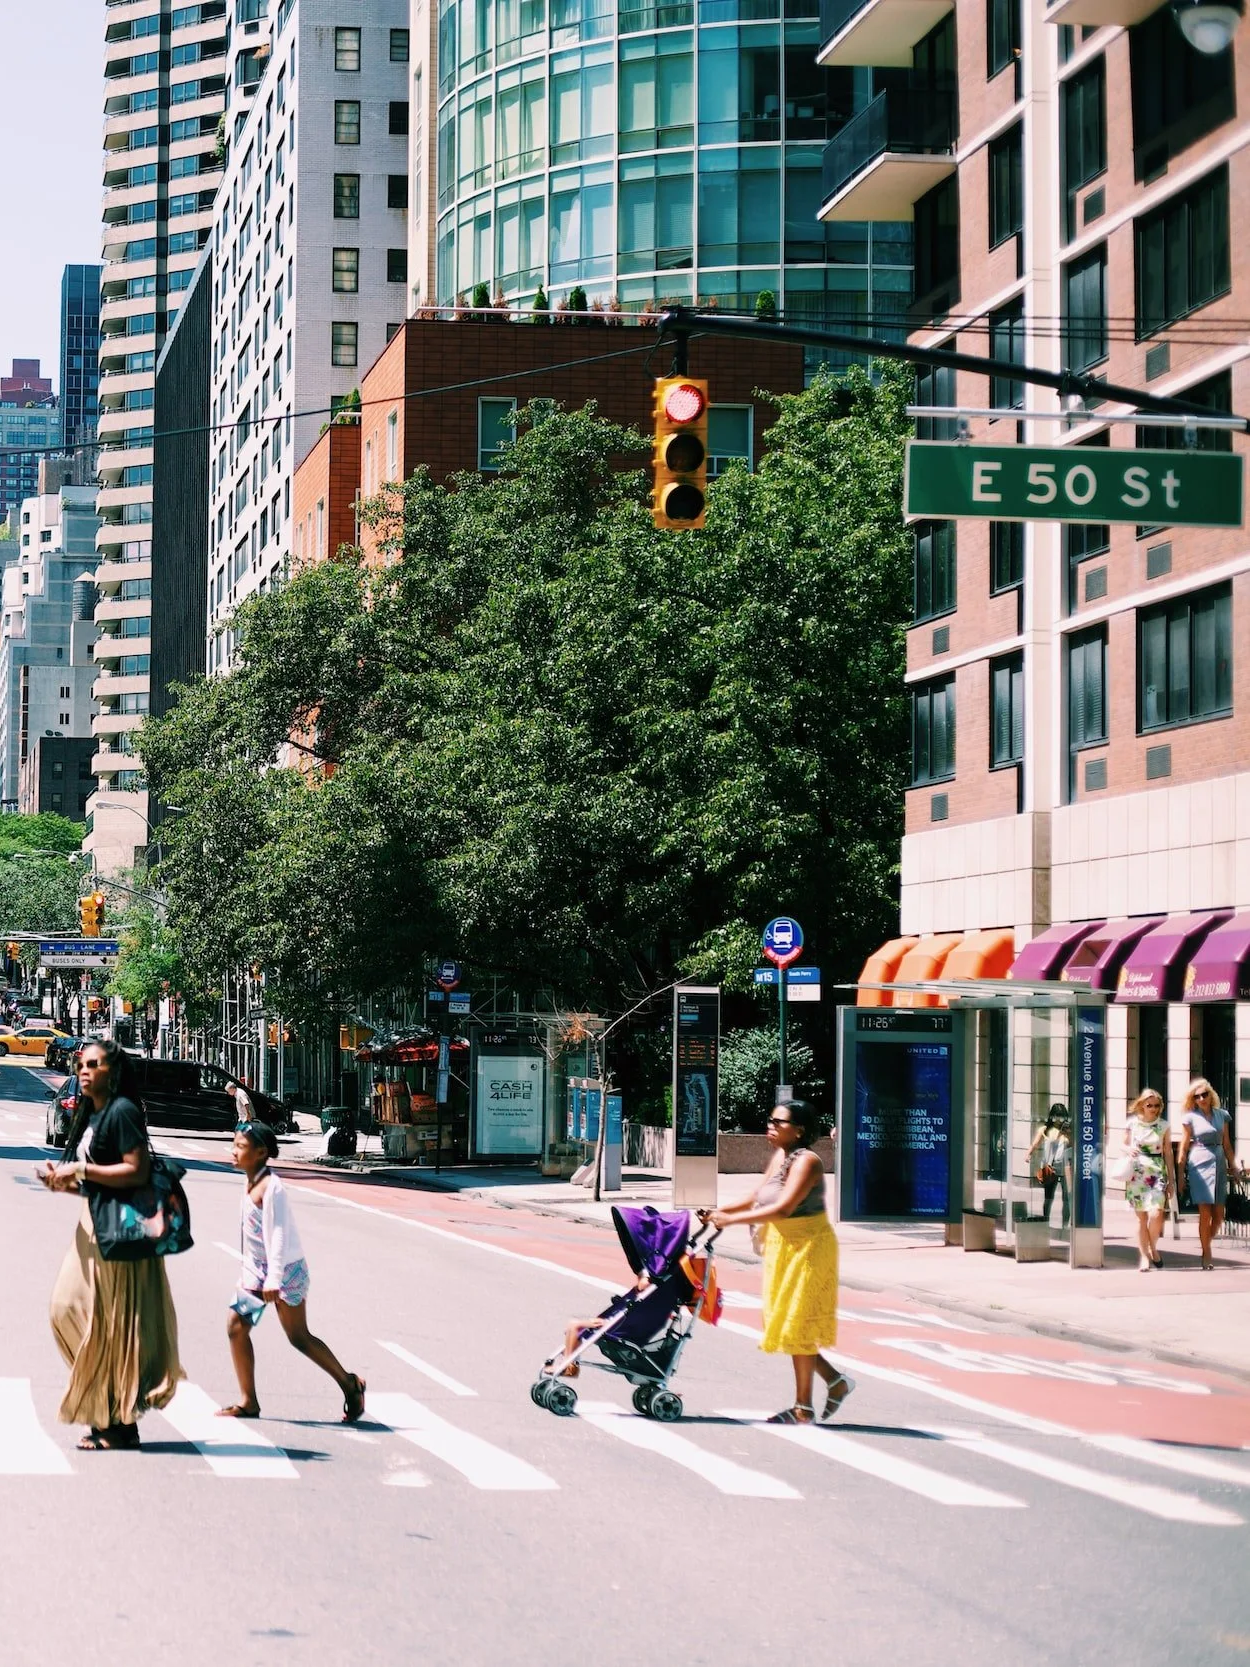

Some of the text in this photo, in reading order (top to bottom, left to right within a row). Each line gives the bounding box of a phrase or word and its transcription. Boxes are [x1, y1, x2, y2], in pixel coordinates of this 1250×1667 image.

[972, 461, 1181, 508] E 50 St
[755, 971, 773, 982] M15
[862, 1017, 889, 1029] 11:26
[490, 1082, 533, 1091] CASH
[490, 1092, 532, 1101] 4LIFE
[1082, 1026, 1095, 1180] 2 Avenue & East 50 Street
[904, 1109, 927, 1117] THAN
[862, 1116, 872, 1124] 30
[898, 1117, 932, 1125] FLIGHTS
[932, 1118, 944, 1126] TO
[929, 1134, 948, 1142] AND
[896, 1142, 936, 1150] AMERICA
